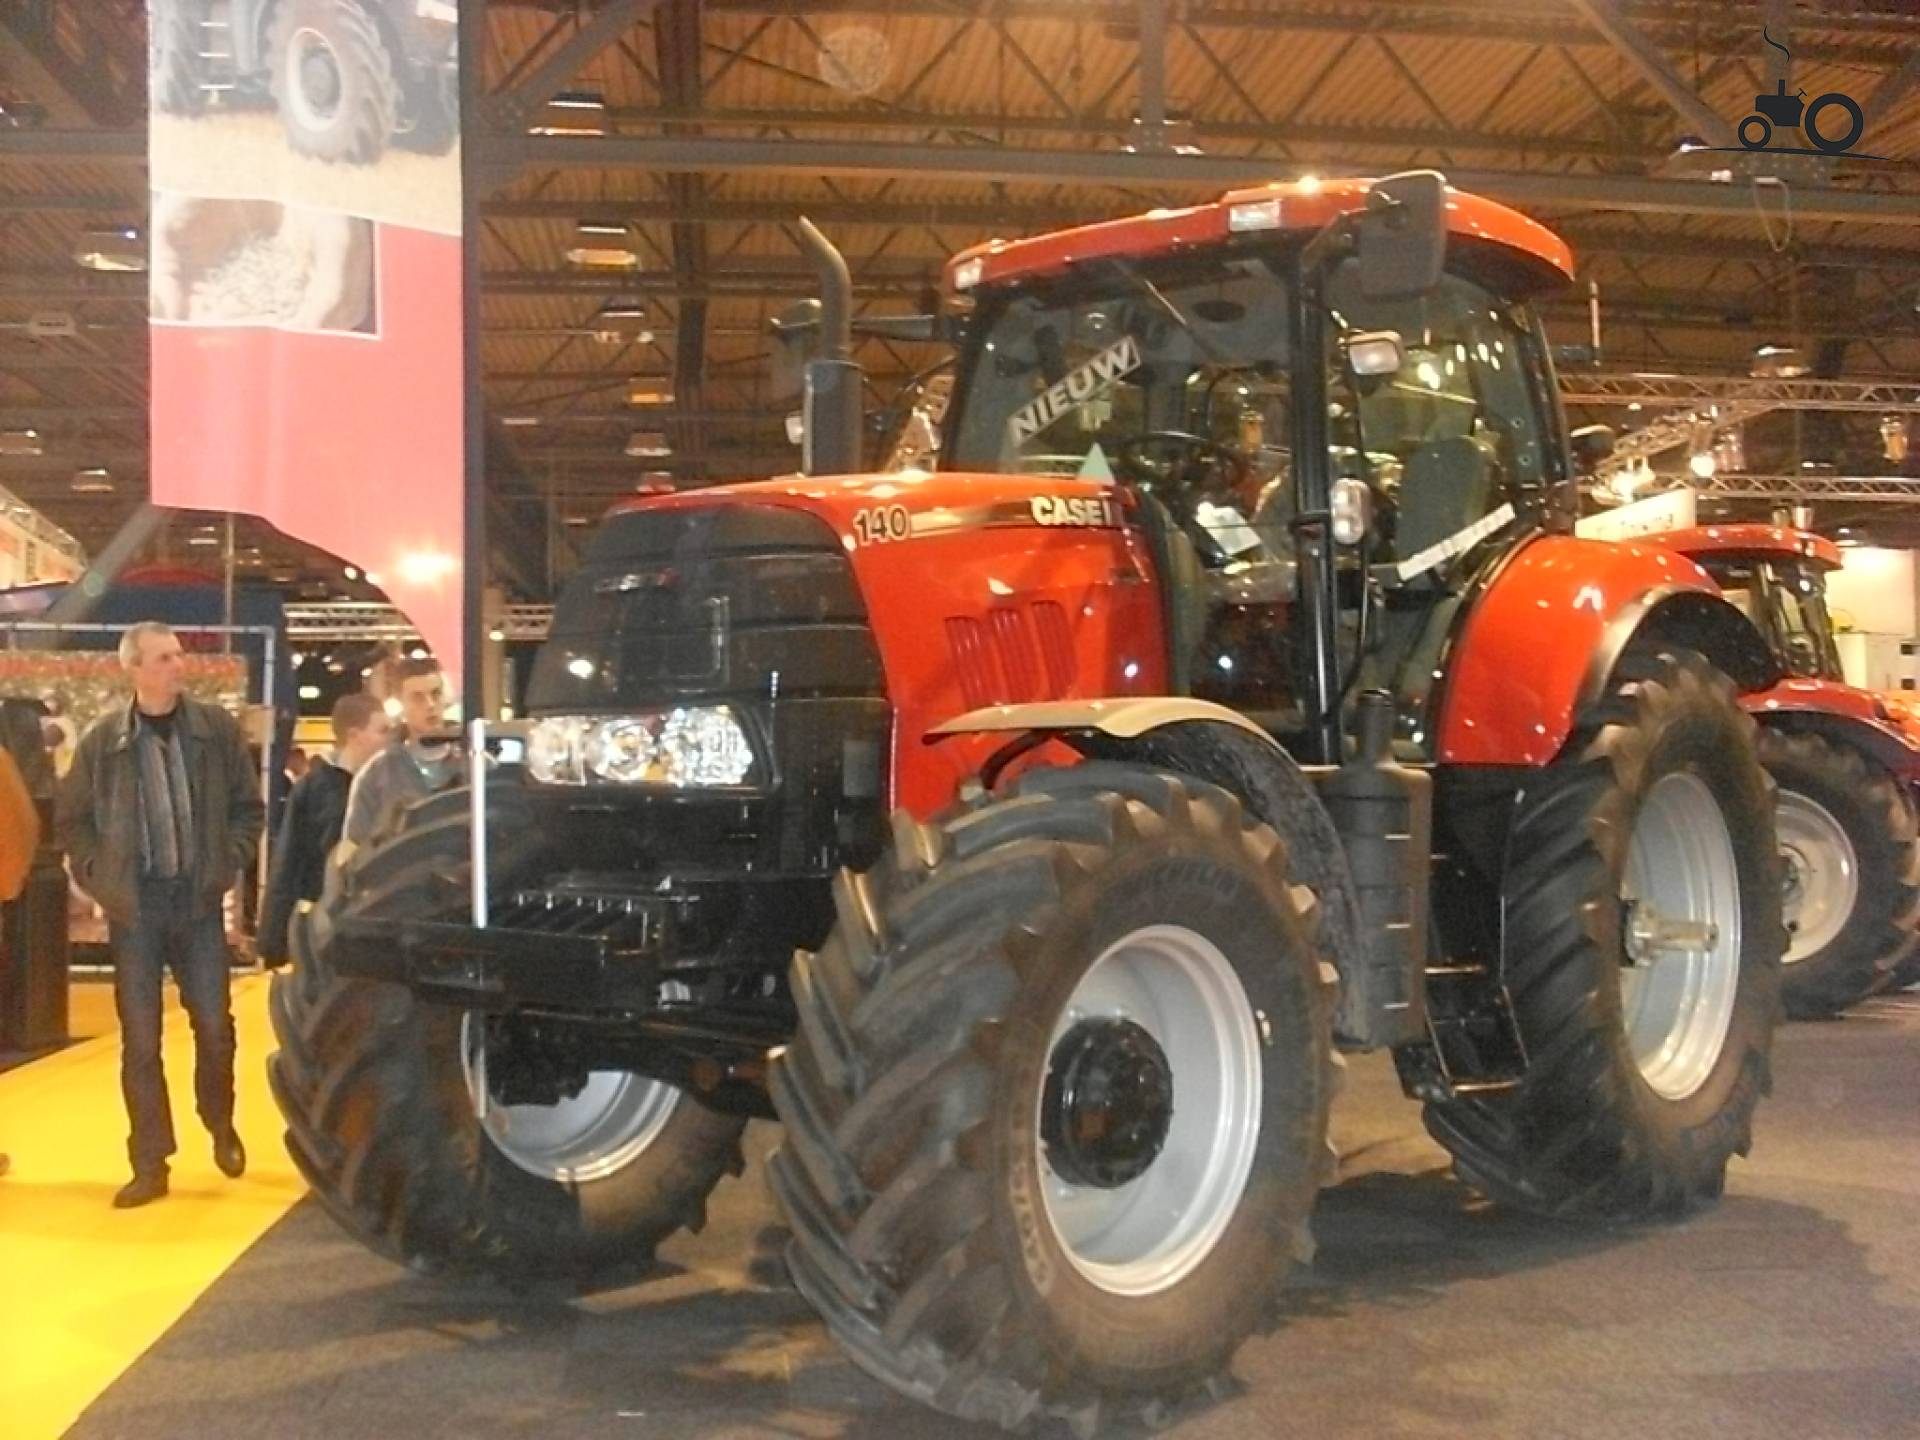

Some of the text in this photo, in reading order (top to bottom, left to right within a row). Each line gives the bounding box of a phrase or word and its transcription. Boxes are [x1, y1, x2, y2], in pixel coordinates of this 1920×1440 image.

[1013, 340, 1130, 442] NIEUW
[853, 504, 908, 546] 140
[1030, 496, 1104, 526] CASE
